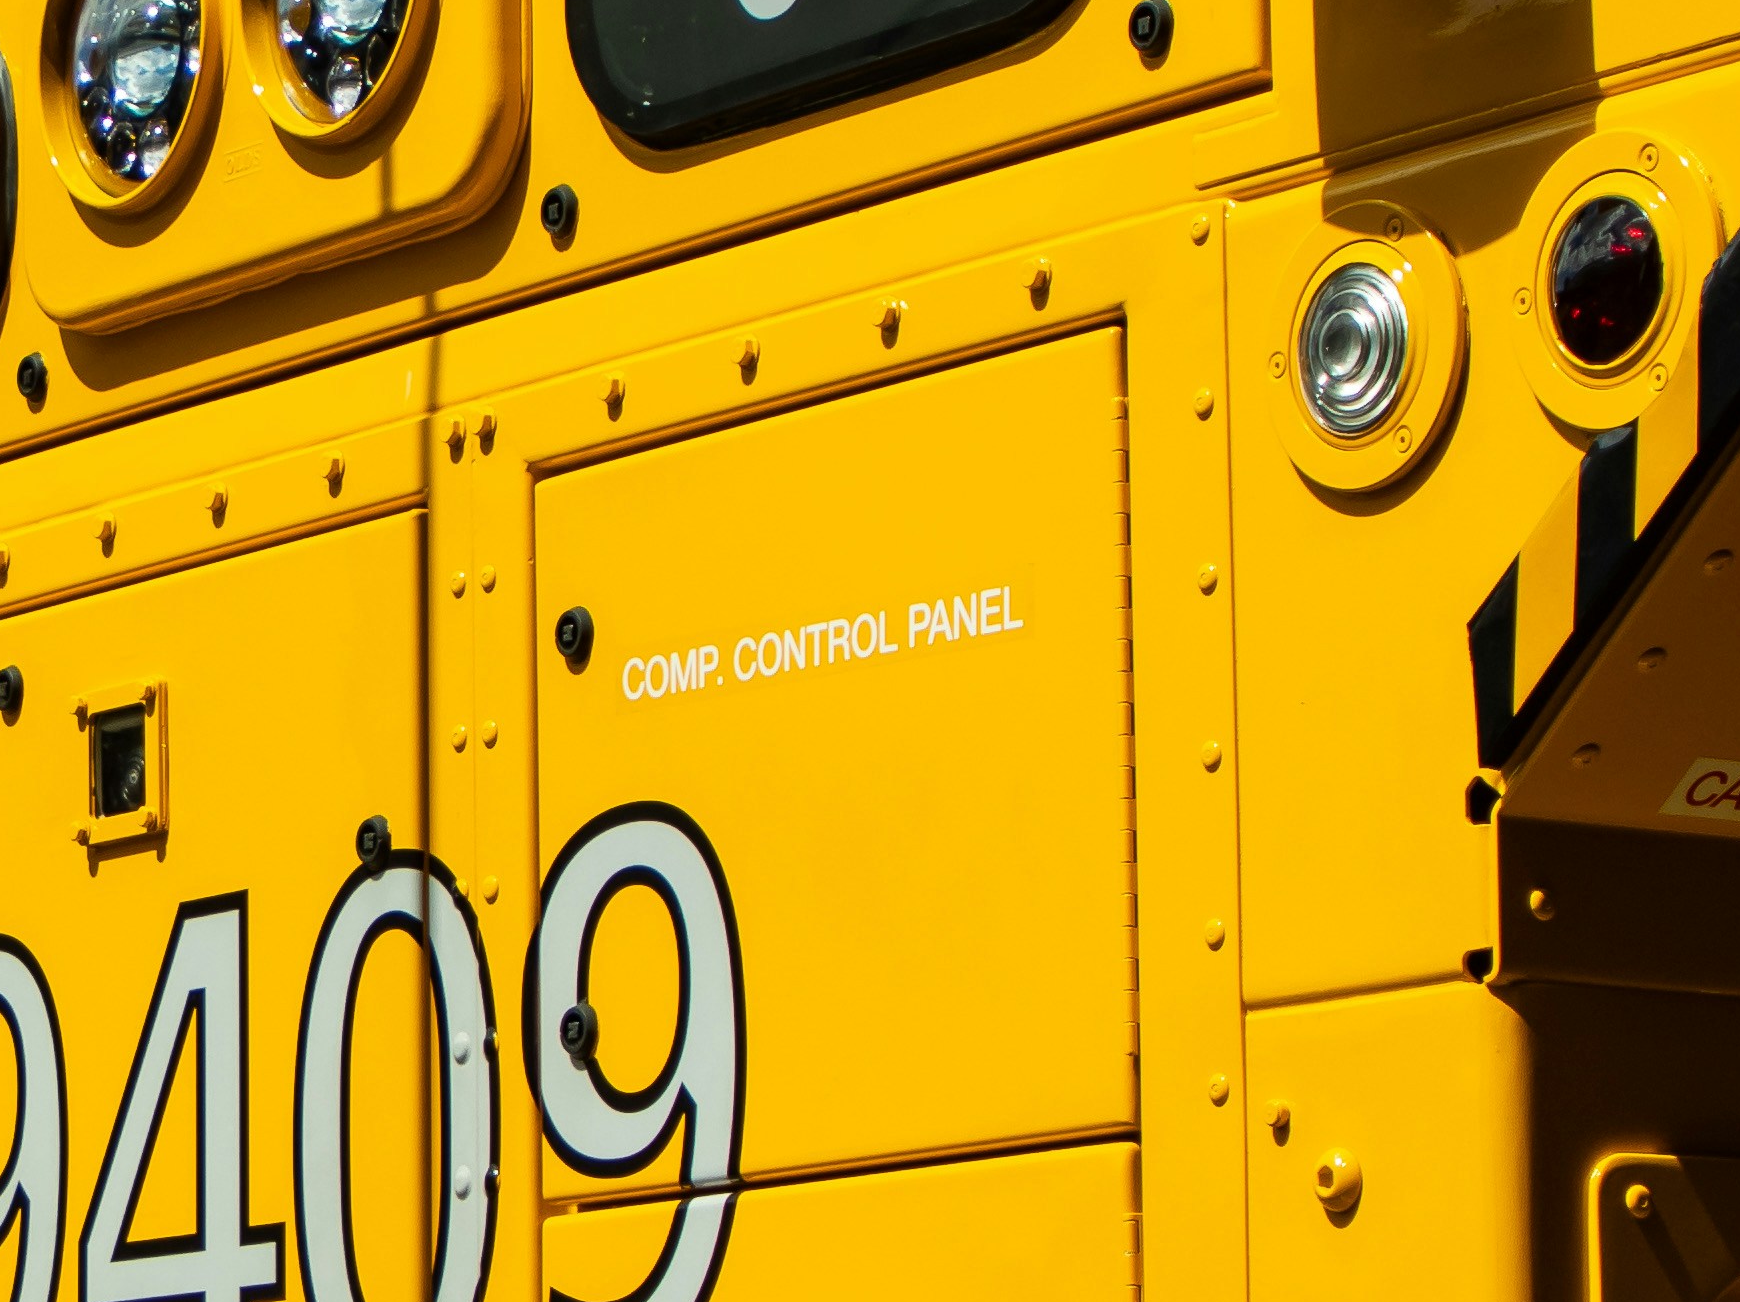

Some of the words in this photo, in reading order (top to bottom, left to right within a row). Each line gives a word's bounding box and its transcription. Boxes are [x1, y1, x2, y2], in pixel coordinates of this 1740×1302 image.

[622, 645, 723, 700] COMP.
[733, 610, 898, 682] CONTROL
[908, 585, 1024, 648] PANEL
